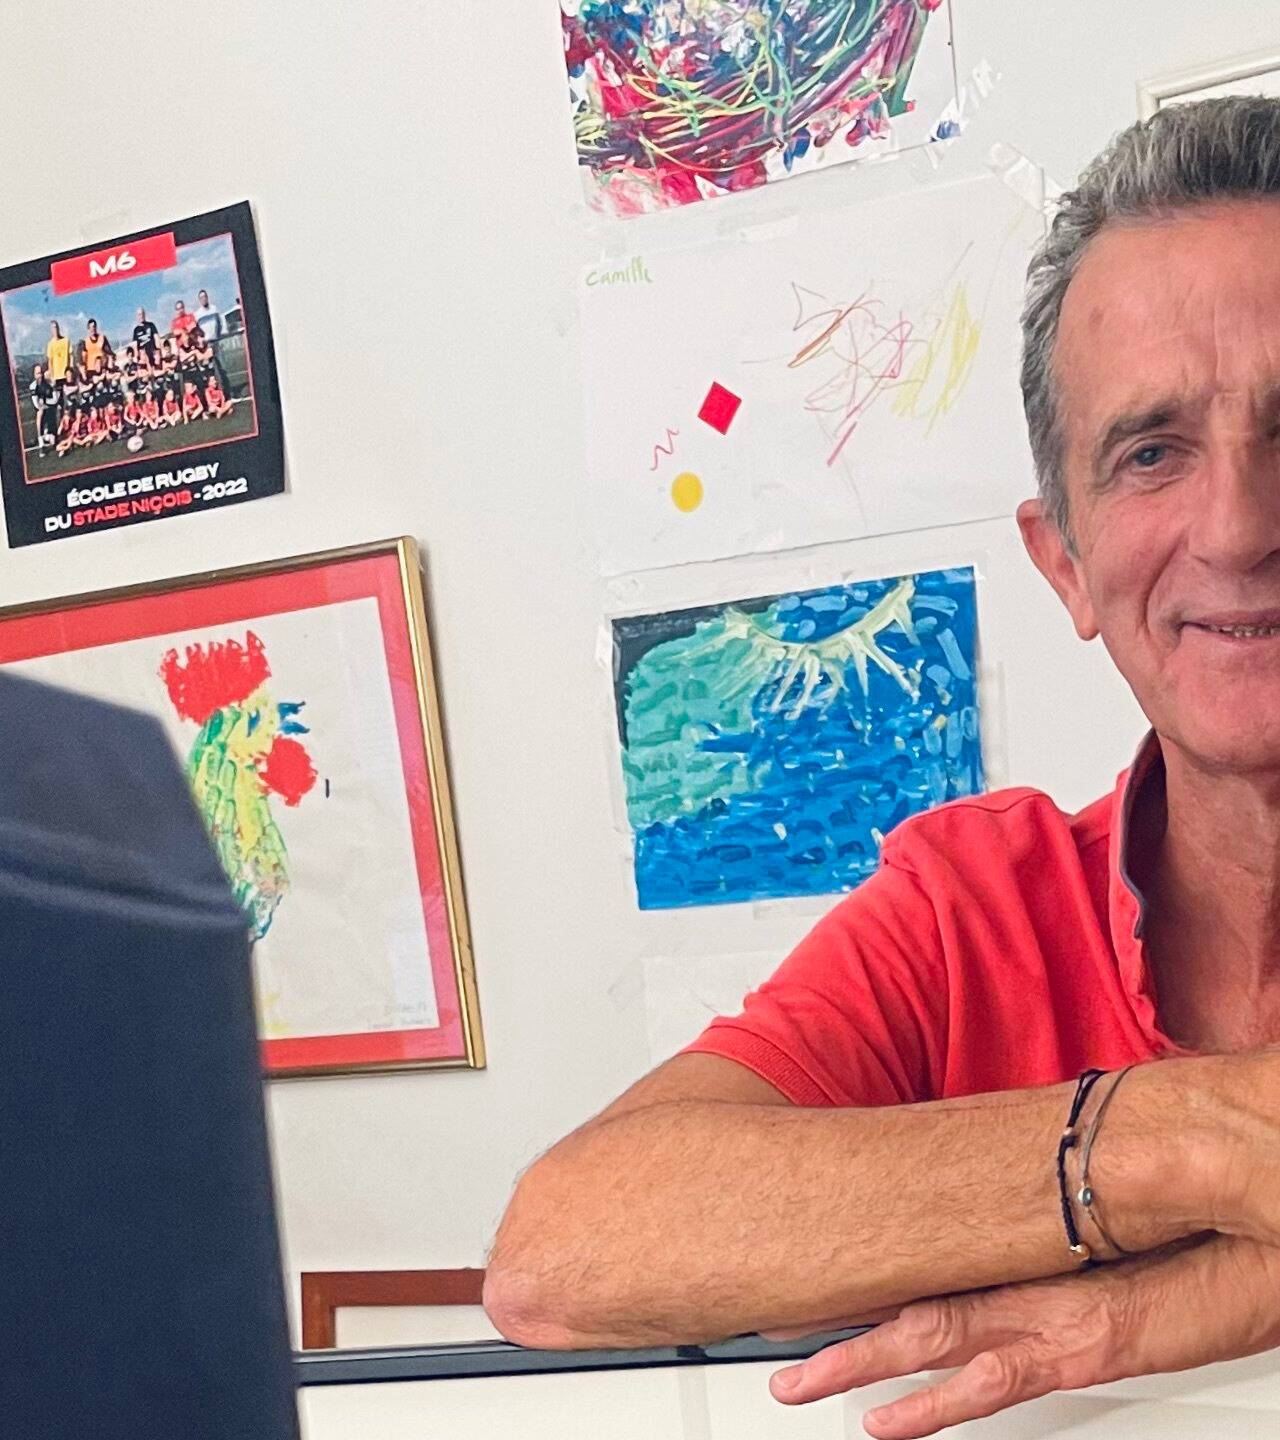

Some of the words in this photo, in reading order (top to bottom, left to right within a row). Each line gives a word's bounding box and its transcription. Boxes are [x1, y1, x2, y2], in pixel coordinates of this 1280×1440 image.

[89, 251, 136, 278] M6
[44, 513, 71, 532] DU
[73, 502, 131, 526] STADE
[132, 490, 193, 515] NIÇOIS
[202, 478, 248, 501] 2022
[67, 482, 127, 508] ÉCOLE
[128, 476, 155, 494] DE
[155, 462, 220, 489] RUGBY
